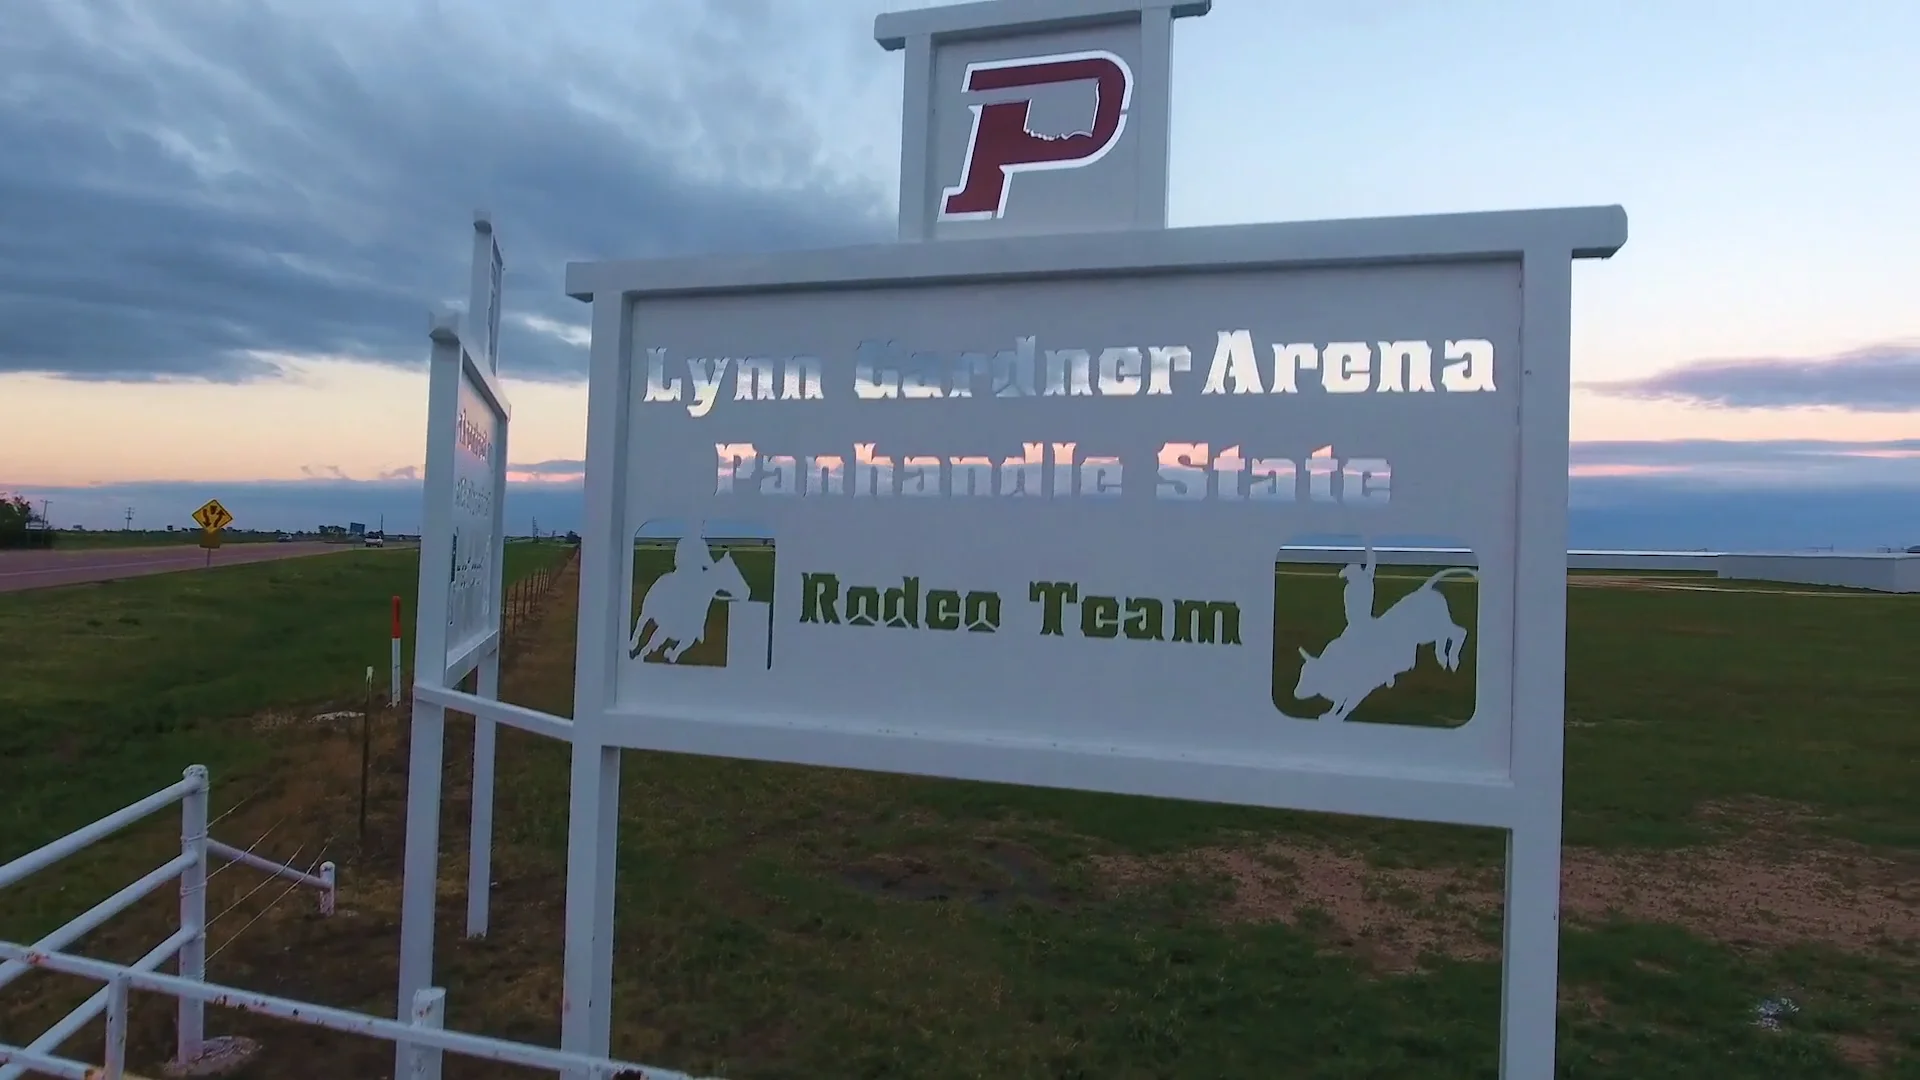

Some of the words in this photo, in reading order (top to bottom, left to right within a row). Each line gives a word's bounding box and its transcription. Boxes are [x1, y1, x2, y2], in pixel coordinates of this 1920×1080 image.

[643, 347, 825, 418] Lynn
[853, 335, 1192, 399] Gardner
[1201, 328, 1497, 395] Arena
[713, 441, 1124, 499] Panhandle
[1156, 441, 1392, 504] State
[799, 572, 1002, 634] Rodeo
[1029, 580, 1243, 646] Team
